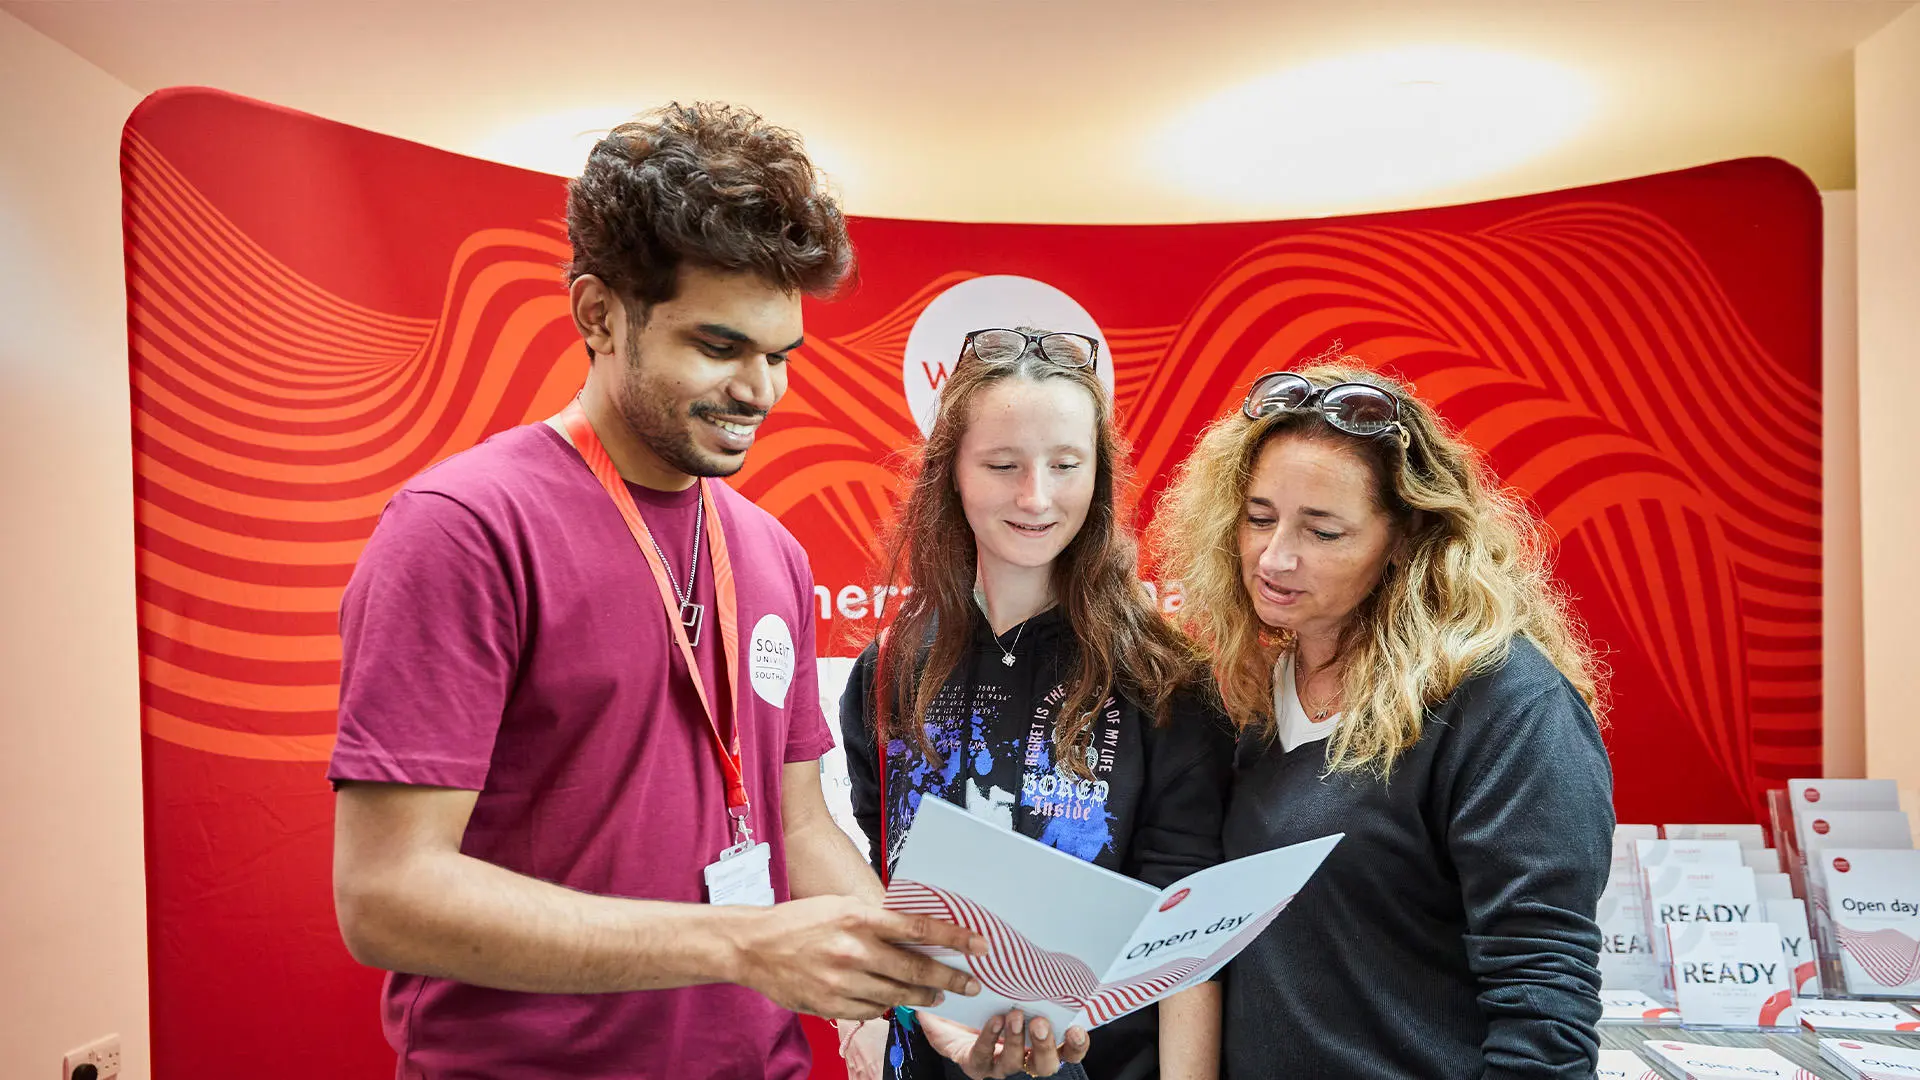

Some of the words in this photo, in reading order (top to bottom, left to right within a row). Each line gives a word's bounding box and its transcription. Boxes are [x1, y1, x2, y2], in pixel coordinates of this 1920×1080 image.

[1044, 684, 1067, 705] THE
[1034, 707, 1049, 720] IS
[1106, 709, 1120, 725] OF
[1025, 723, 1045, 767] REGRET
[1104, 728, 1119, 747] MY
[1098, 747, 1116, 772] LIFE
[1022, 772, 1110, 804] BORED
[1029, 795, 1092, 821] Inside
[1660, 903, 1752, 924] READY
[1842, 897, 1886, 915] Open
[1890, 899, 1920, 917] day
[1126, 929, 1198, 960] Open
[1204, 911, 1255, 934] day
[1683, 962, 1778, 985] READY
